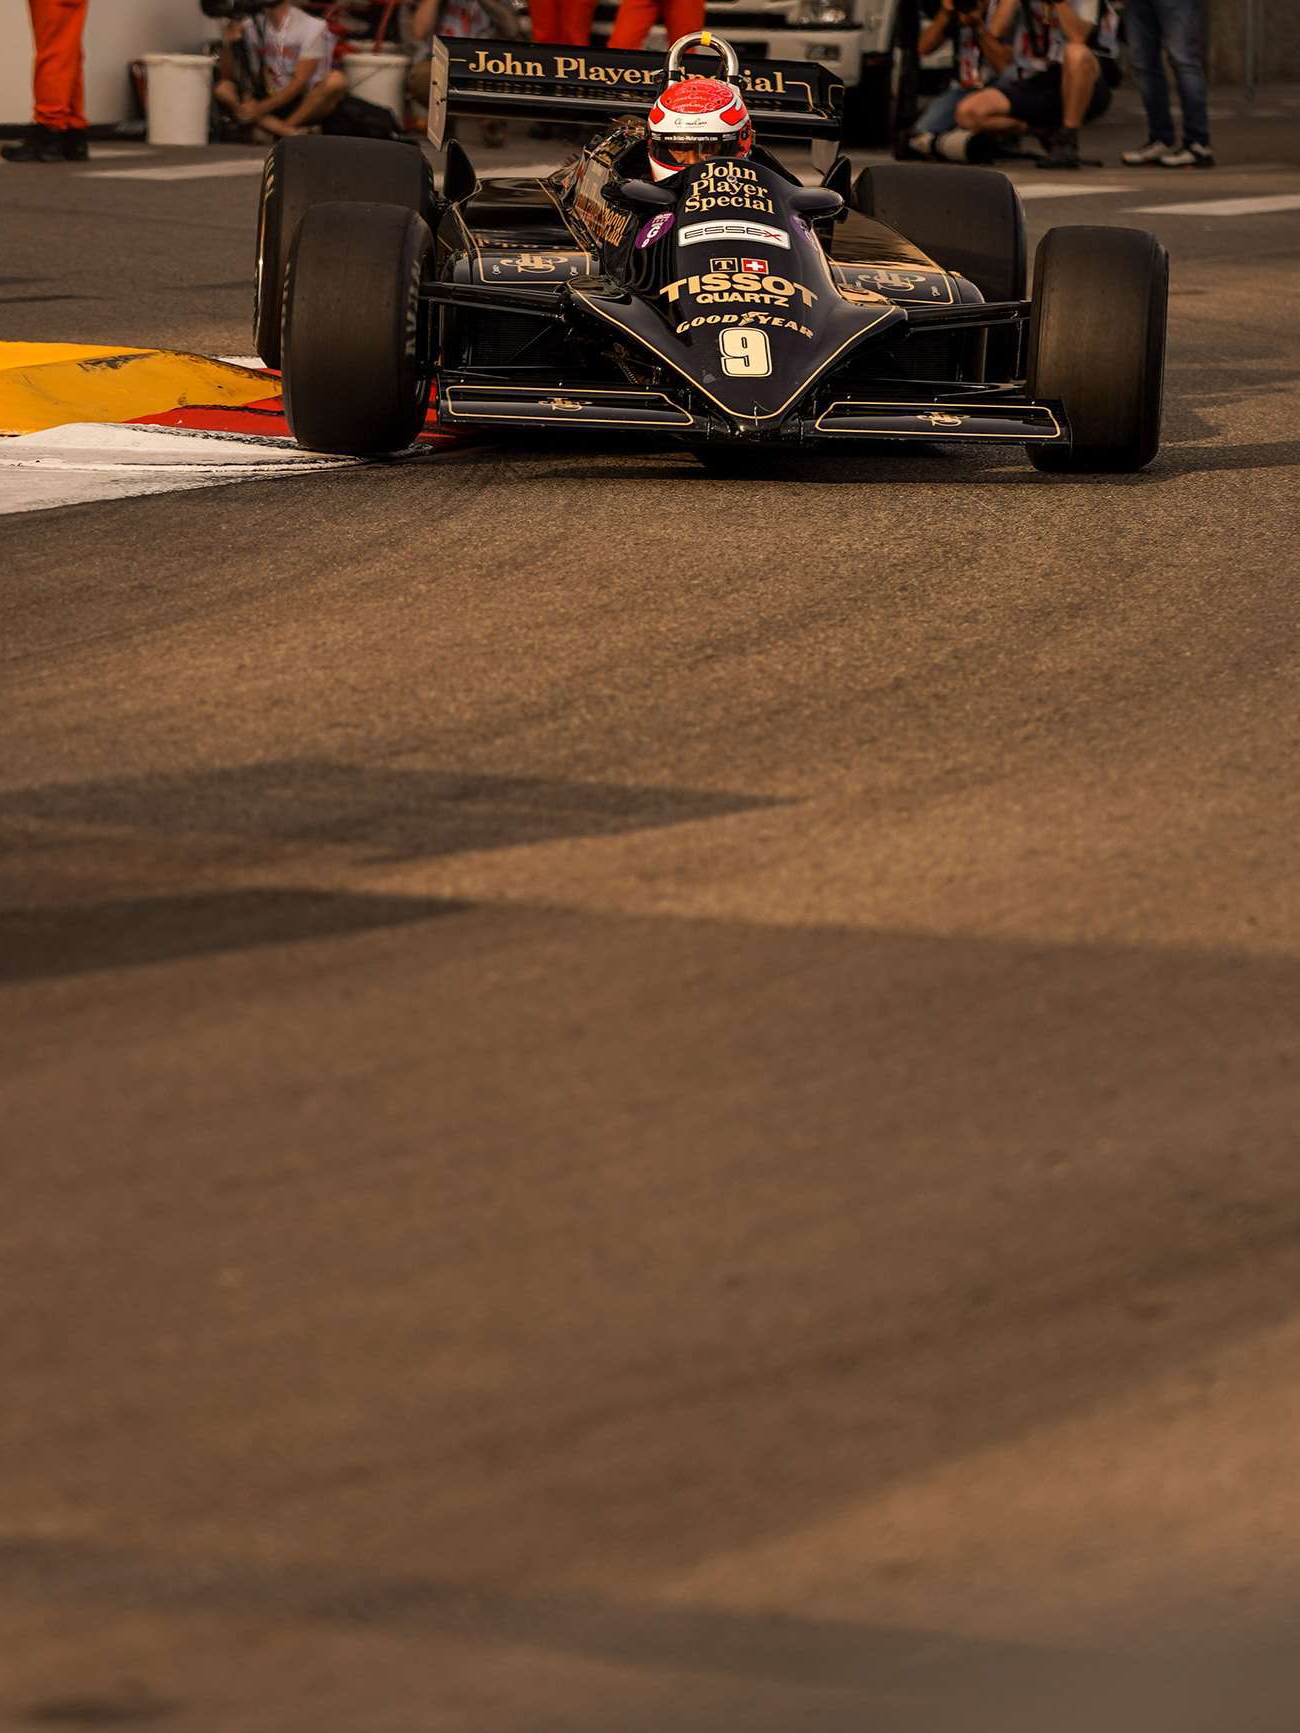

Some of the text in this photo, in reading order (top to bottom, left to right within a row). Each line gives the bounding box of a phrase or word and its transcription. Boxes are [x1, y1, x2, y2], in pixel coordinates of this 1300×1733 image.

[468, 51, 545, 77] John
[554, 56, 654, 86] Player
[701, 162, 759, 182] John
[691, 177, 769, 198] Player
[684, 194, 775, 215] Special
[684, 225, 783, 242] ESSEX
[714, 260, 734, 271] T
[659, 273, 819, 308] TISSOT
[696, 292, 790, 307] QUARTZ
[676, 311, 814, 340] GOODYEAR
[718, 327, 773, 378] 9
